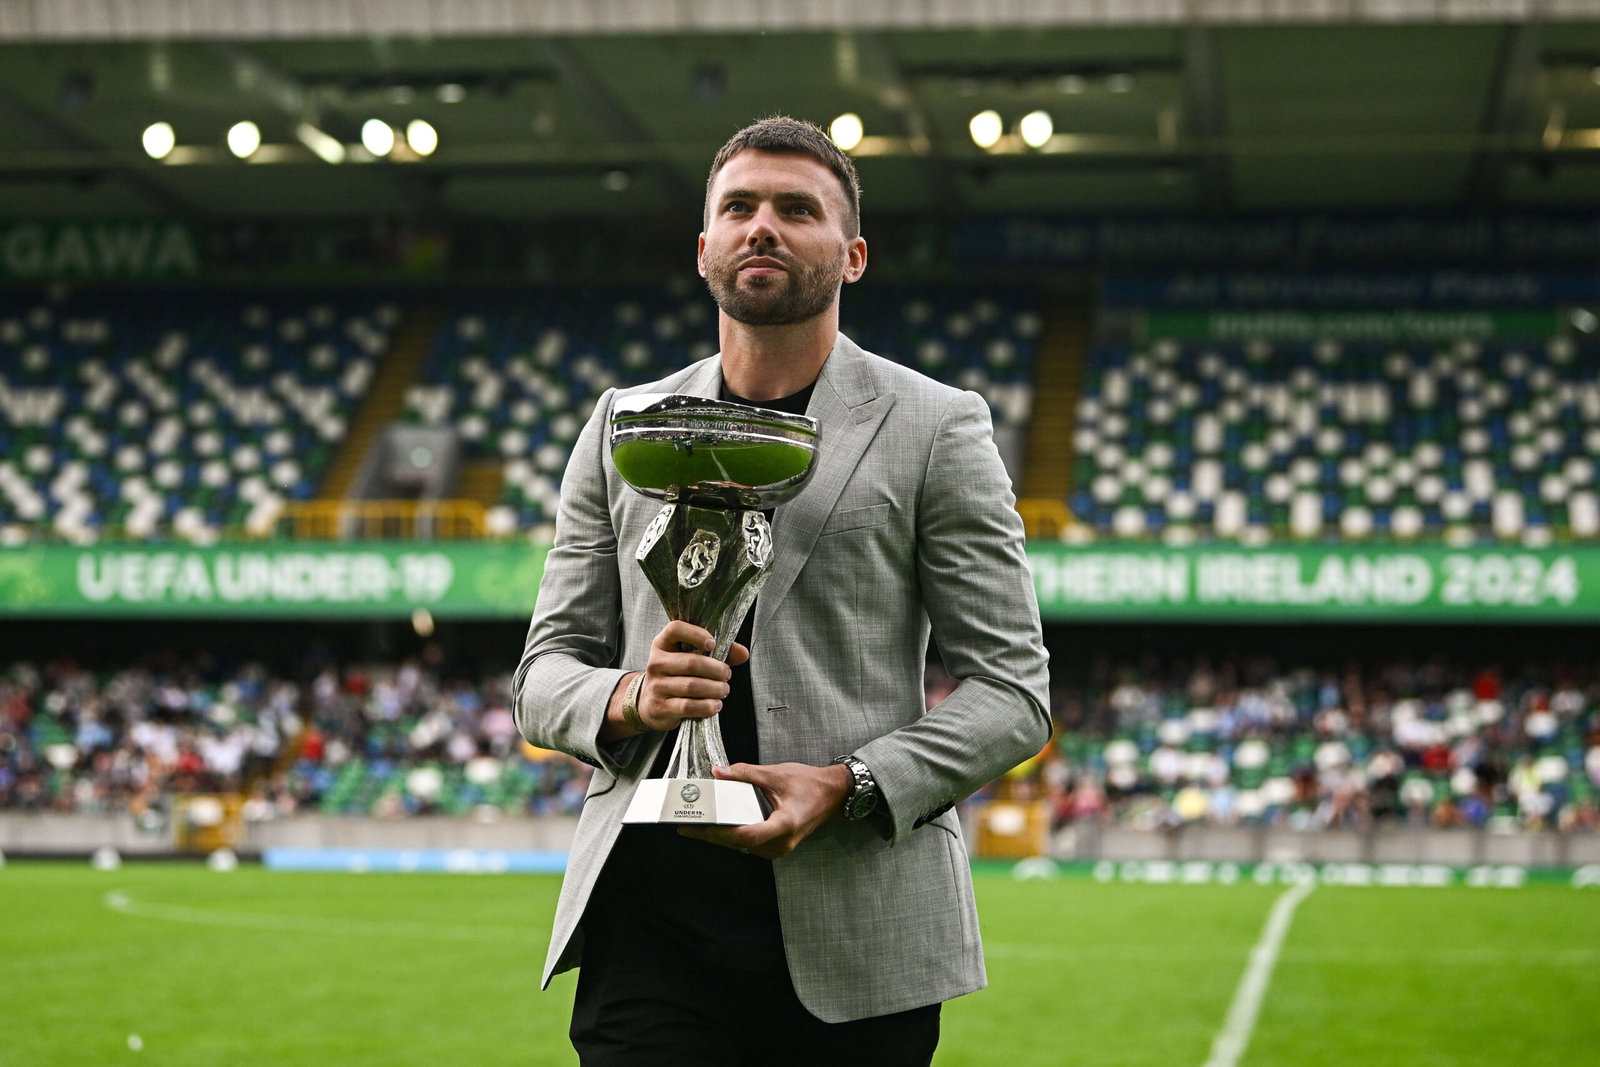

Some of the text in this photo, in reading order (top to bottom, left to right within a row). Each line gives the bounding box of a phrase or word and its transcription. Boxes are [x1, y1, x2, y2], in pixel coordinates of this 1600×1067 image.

[4, 222, 197, 273] GAWA
[76, 553, 455, 602] UEFA UNDER-19
[1195, 554, 1432, 605] IRELAND
[1441, 555, 1578, 606] 2024
